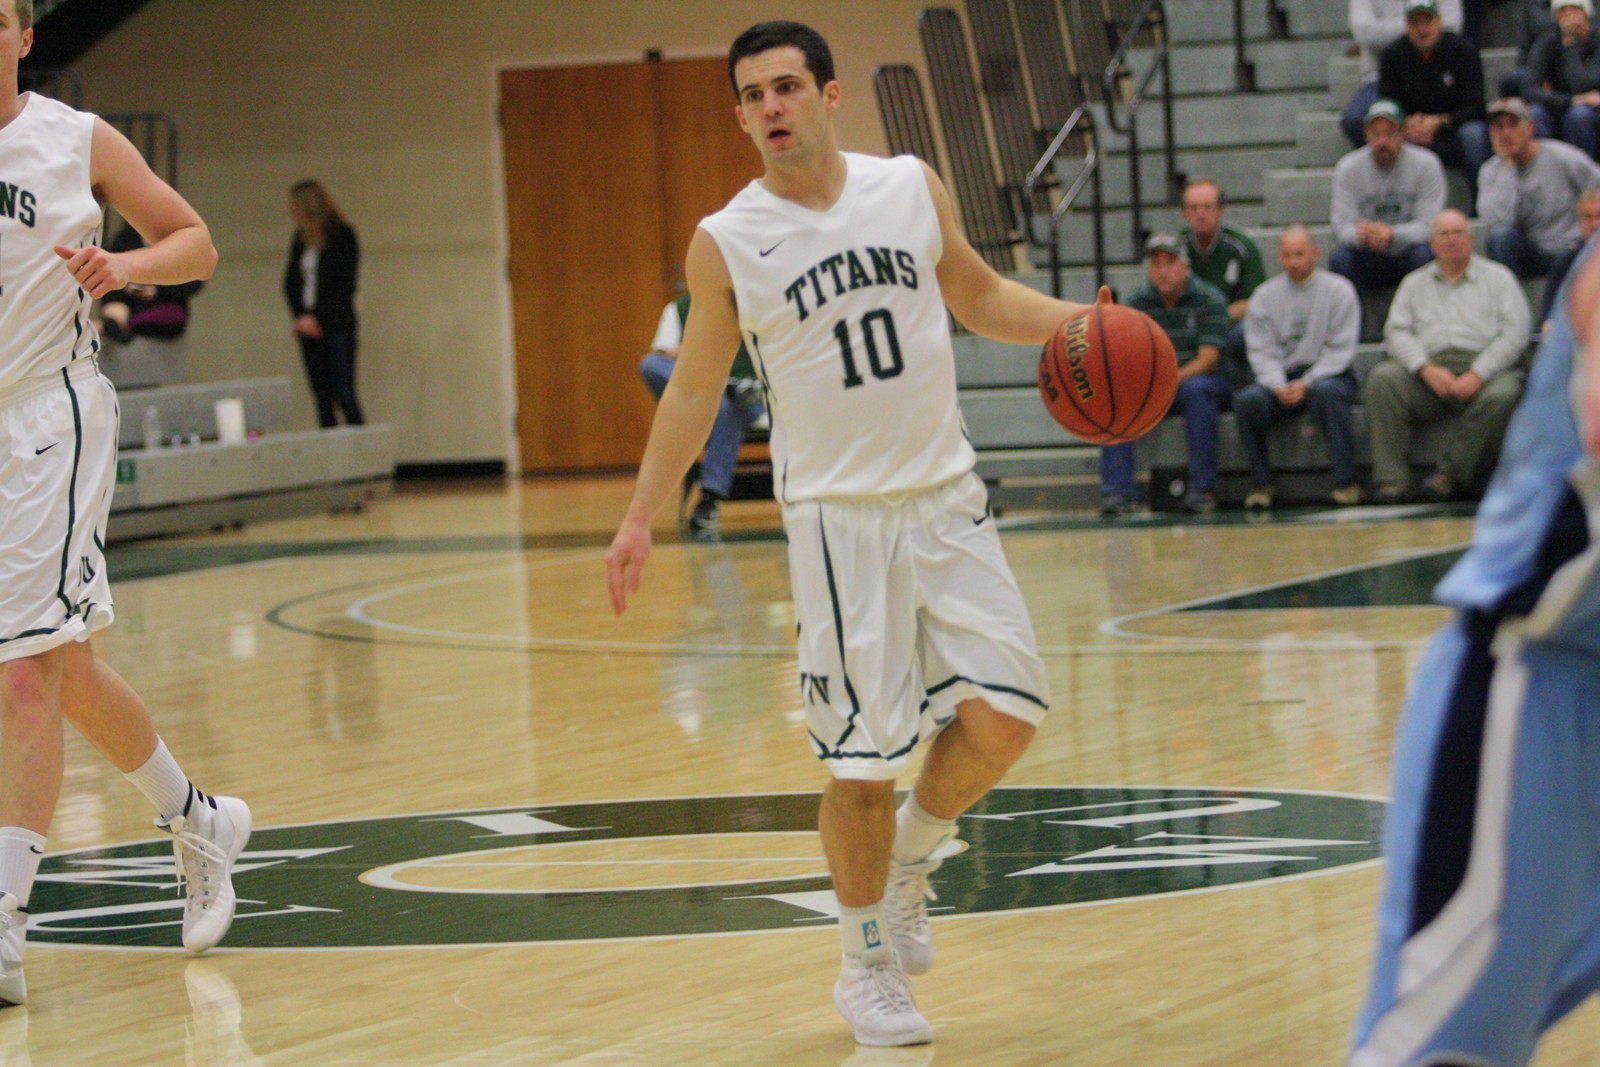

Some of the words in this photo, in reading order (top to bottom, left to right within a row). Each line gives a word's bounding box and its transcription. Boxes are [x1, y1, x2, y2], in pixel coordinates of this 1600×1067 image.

[784, 246, 918, 322] TITANS
[833, 307, 905, 390] 10
[1065, 315, 1095, 401] Wilson
